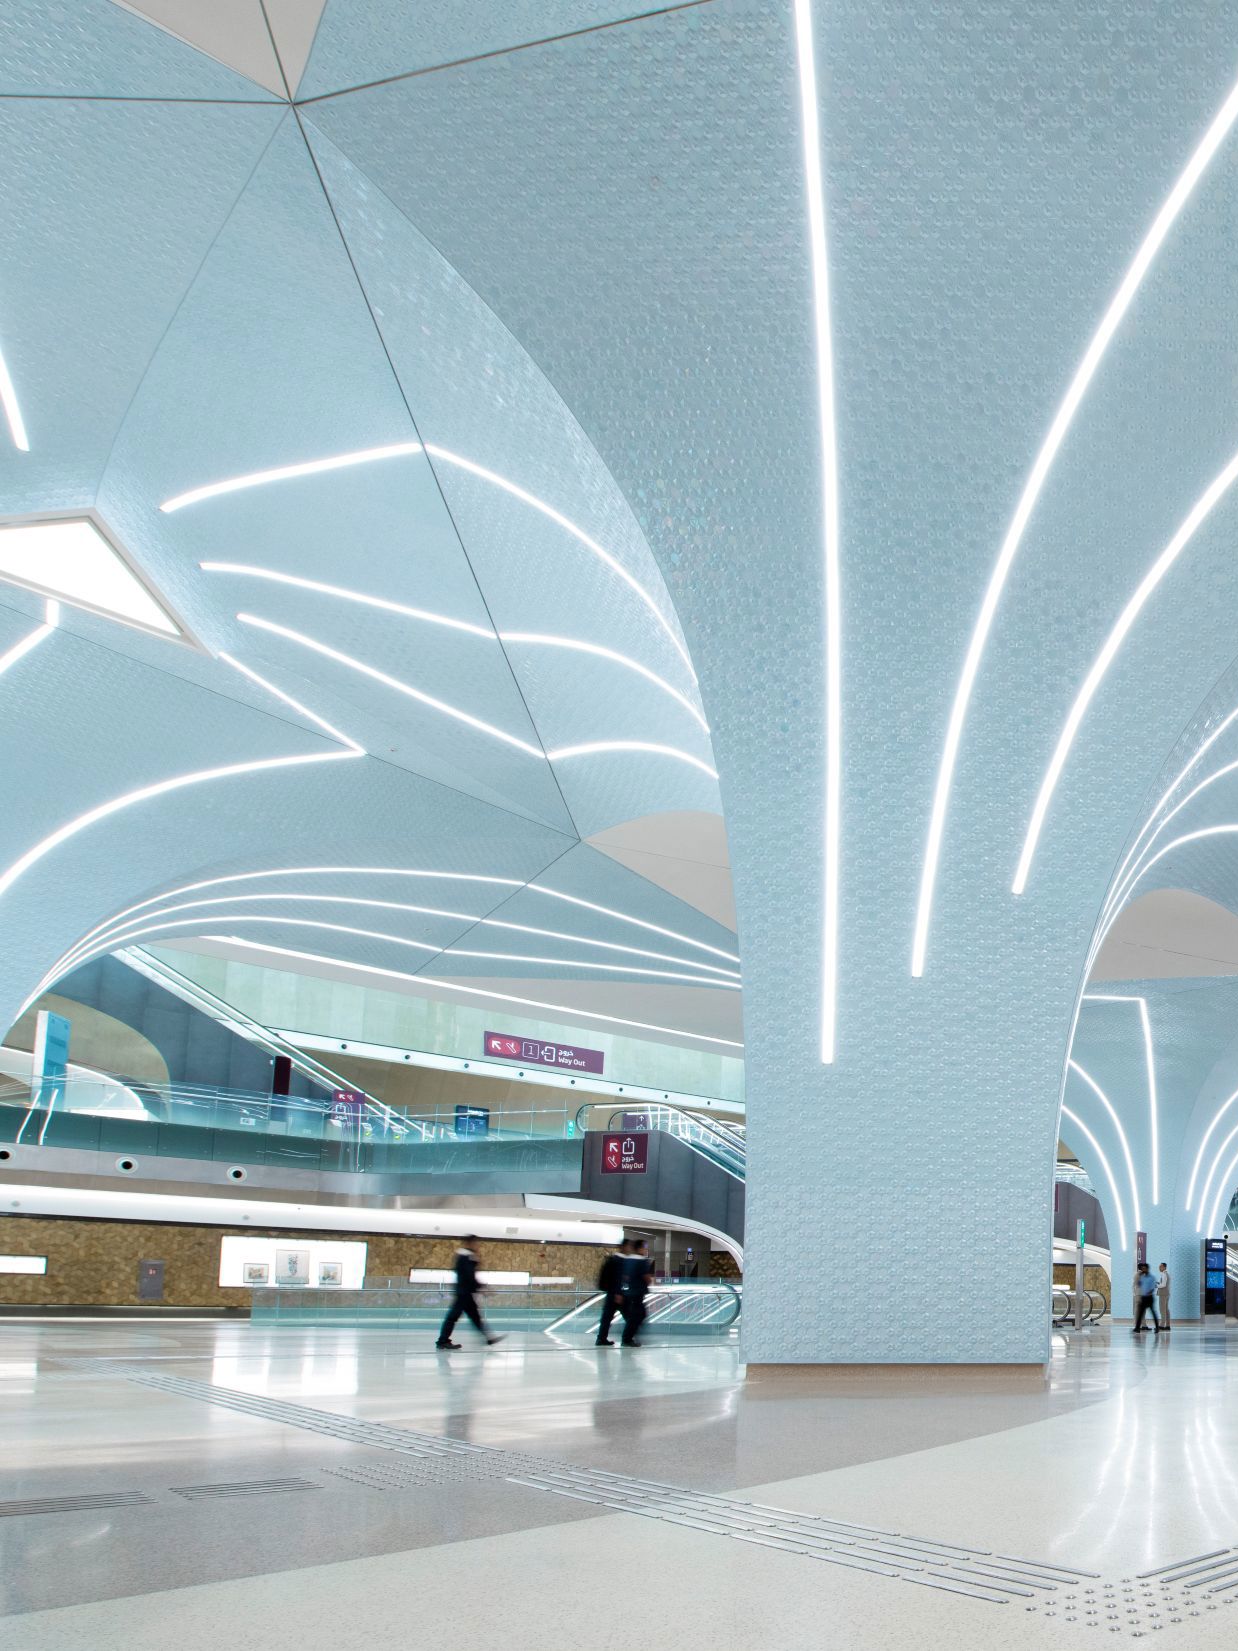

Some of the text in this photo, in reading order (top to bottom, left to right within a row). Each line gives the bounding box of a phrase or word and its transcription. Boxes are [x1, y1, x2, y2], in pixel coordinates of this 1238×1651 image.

[558, 1049, 574, 1057] خروج
[558, 1056, 586, 1067] Way Out
[621, 1155, 634, 1163] خروج
[621, 1162, 634, 1170] Way
